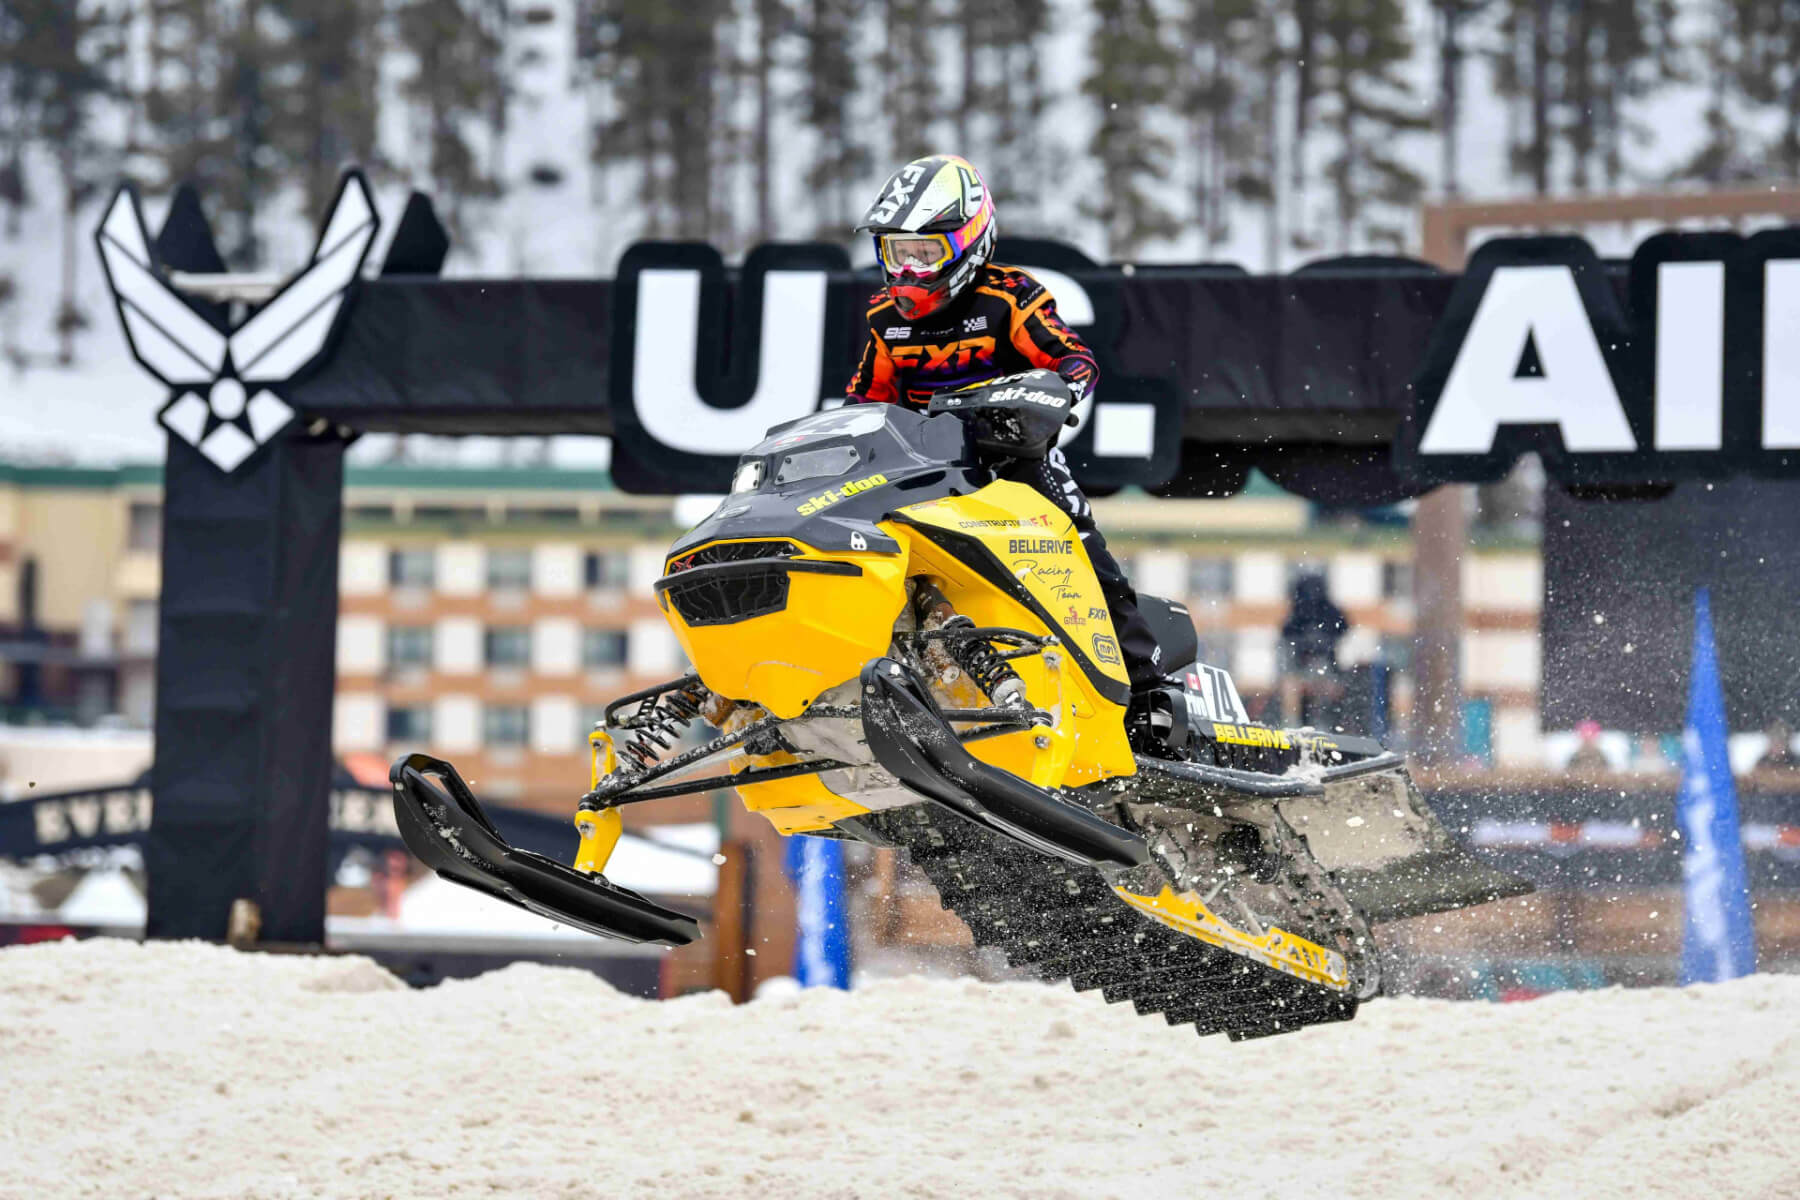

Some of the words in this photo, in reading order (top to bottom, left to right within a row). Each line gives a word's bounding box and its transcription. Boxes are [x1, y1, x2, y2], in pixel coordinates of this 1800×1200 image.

[869, 164, 926, 225] FXR
[889, 335, 997, 376] FXR
[1419, 257, 1800, 454] AI
[988, 386, 1067, 408] ski-doo
[796, 473, 889, 517] ski-doo
[1008, 539, 1073, 555] BELLERIVE
[1012, 559, 1074, 585] Racing
[1050, 584, 1083, 602] Team
[1087, 607, 1108, 621] FXR
[1203, 666, 1239, 721] 74
[1212, 722, 1291, 750] BELLERIVE
